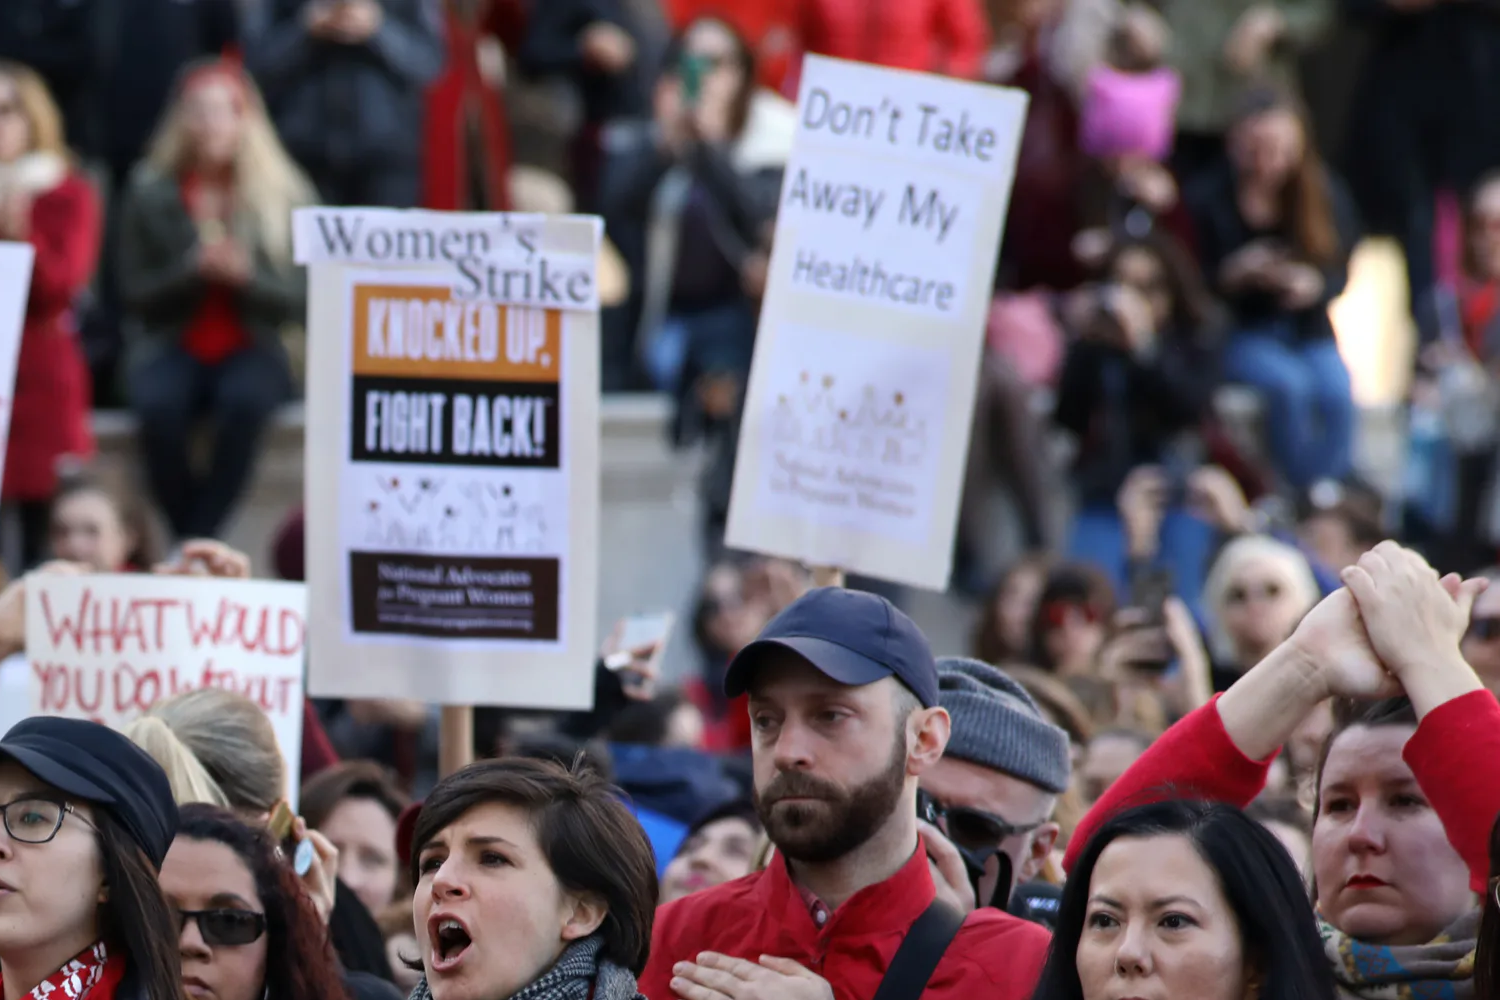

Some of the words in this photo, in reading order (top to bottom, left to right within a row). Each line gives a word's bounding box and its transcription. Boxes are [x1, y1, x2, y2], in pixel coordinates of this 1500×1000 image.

[803, 87, 903, 145] Don't
[917, 103, 997, 162] Take
[787, 167, 886, 230] Away
[899, 184, 960, 244] My
[455, 257, 592, 303] Strike
[793, 249, 956, 313] Healthcare
[366, 297, 499, 363] KNOCKED
[505, 304, 553, 368] UP.
[365, 390, 448, 454] FIGHT
[452, 393, 547, 458] BACK!
[40, 587, 181, 654] WHAT
[186, 595, 307, 657] WOULD
[31, 659, 103, 714] YOU
[112, 662, 161, 713] DO
